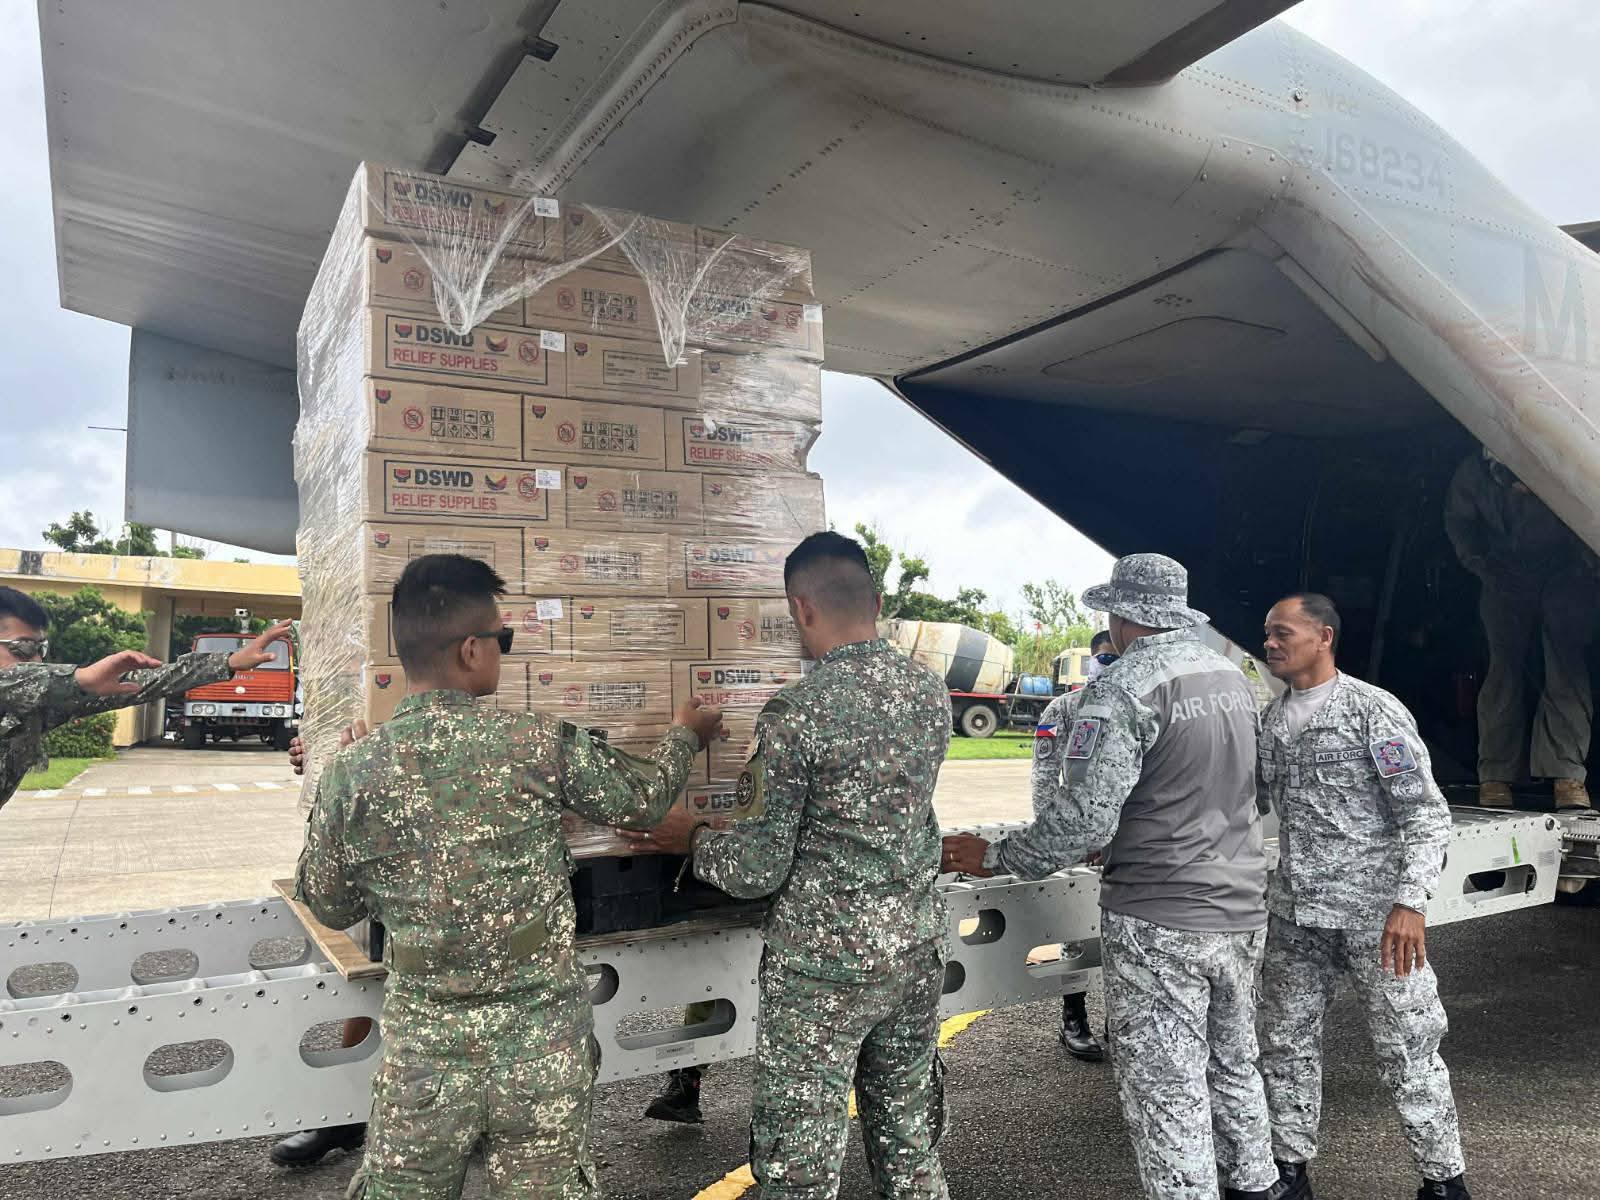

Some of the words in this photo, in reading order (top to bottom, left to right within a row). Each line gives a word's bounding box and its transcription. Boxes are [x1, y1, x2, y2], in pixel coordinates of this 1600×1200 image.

[1324, 127, 1445, 198] 168234
[415, 183, 473, 208] DSWD
[416, 325, 474, 347] DSWD
[393, 348, 437, 364] RELIEF
[440, 353, 498, 372] SUPPLIES
[690, 446, 724, 460] RELIEF
[414, 469, 474, 488] DSWD
[392, 492, 436, 507] RELIEF
[439, 495, 497, 510] SUPPLIES
[714, 669, 761, 684] DSWD
[1171, 696, 1208, 724] AIR
[1318, 753, 1334, 761] AIR
[1337, 749, 1368, 760] FORCE
